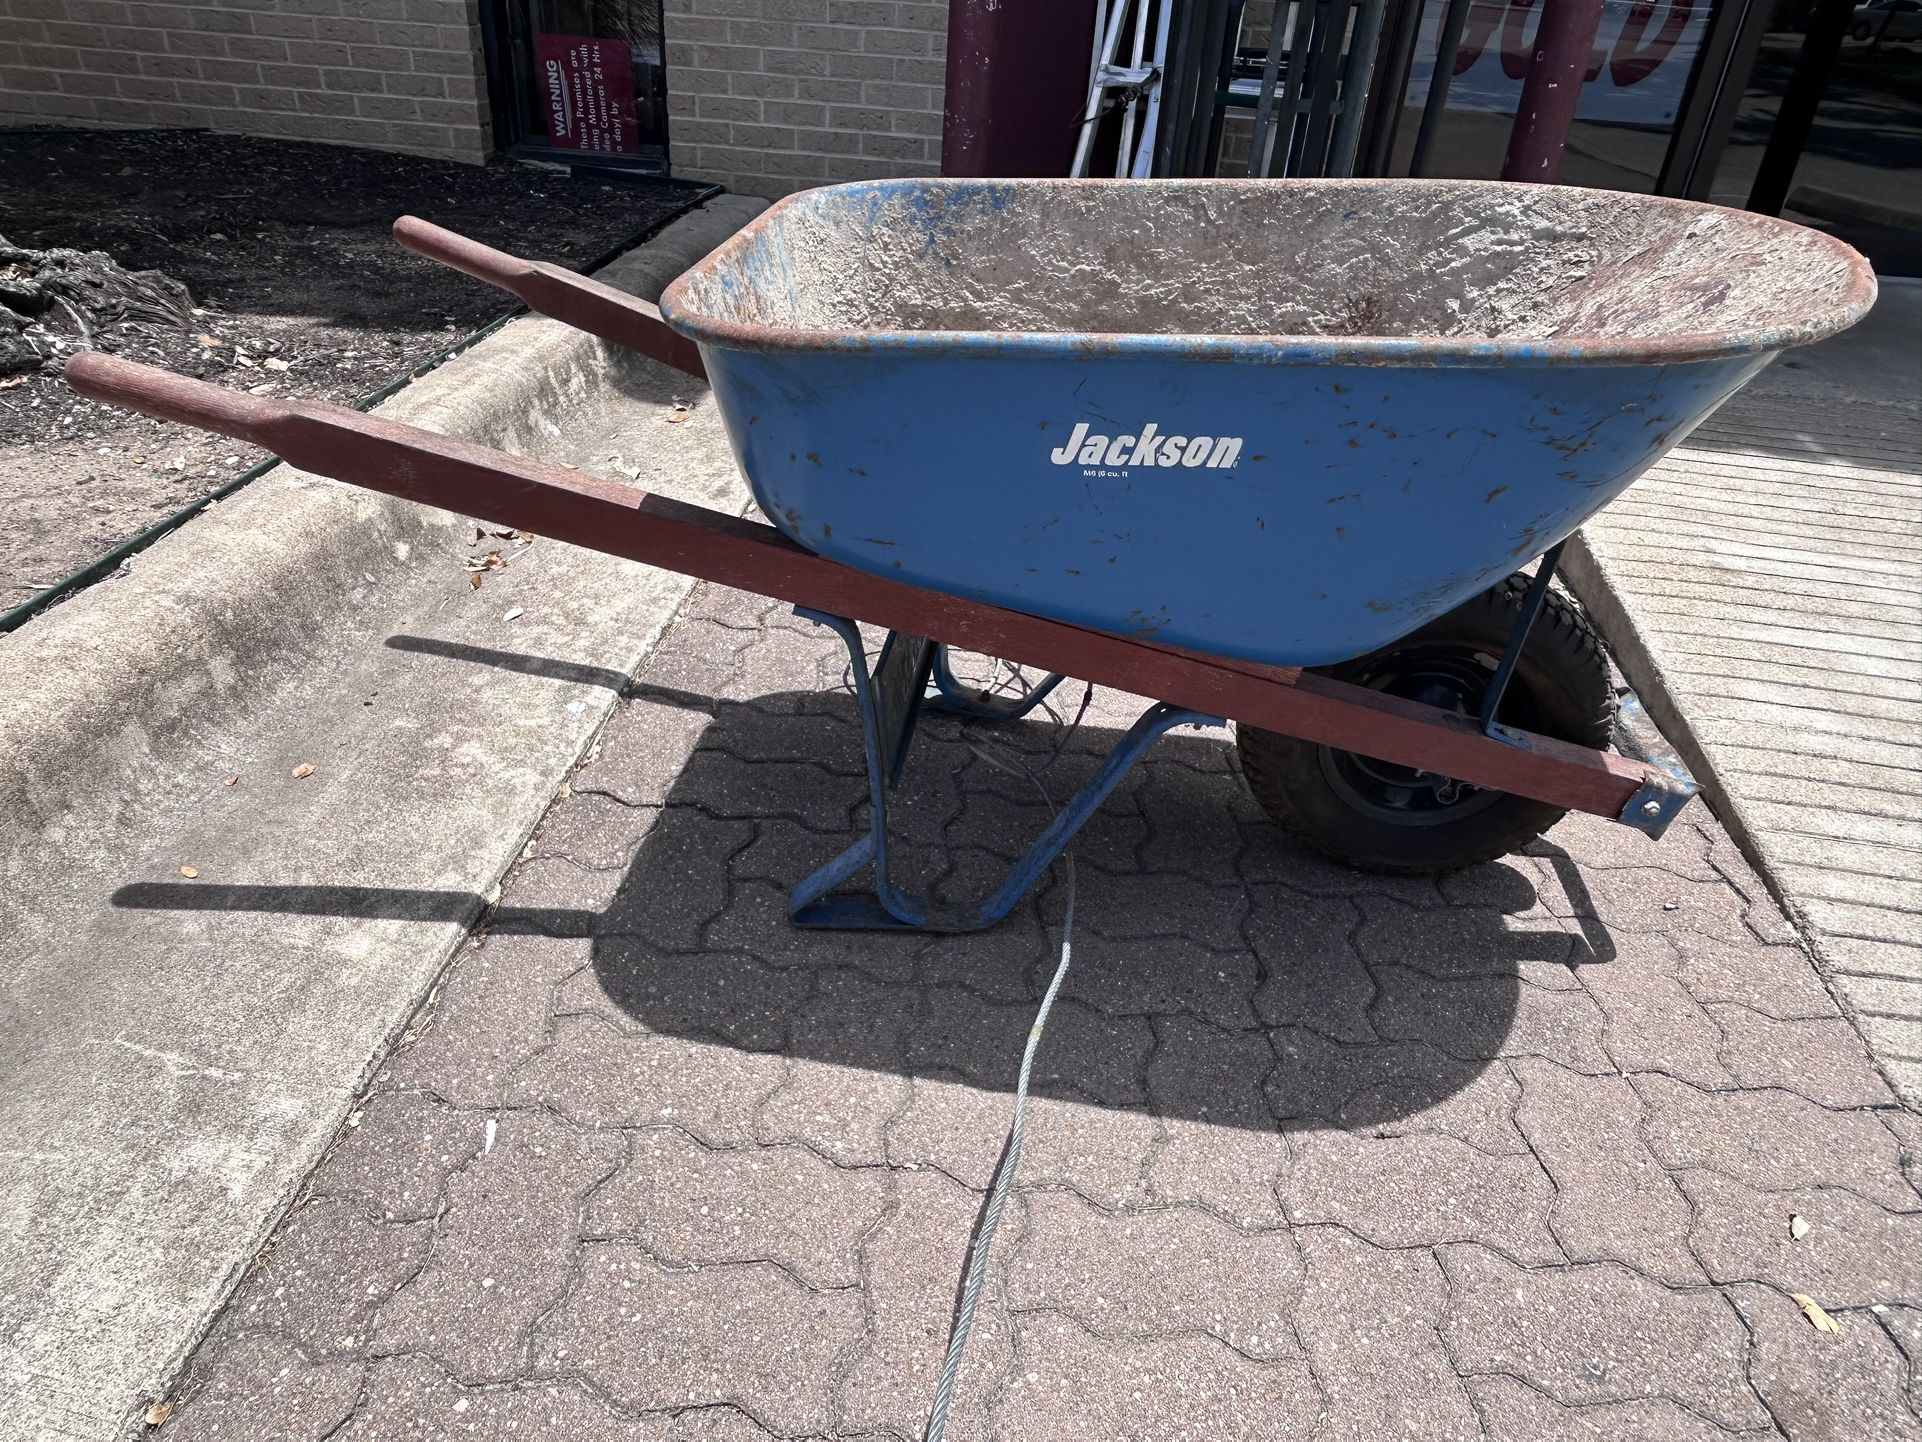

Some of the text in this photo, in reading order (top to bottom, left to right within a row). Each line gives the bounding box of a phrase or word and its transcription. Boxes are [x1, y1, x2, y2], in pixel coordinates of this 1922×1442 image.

[593, 67, 603, 80] 24
[546, 60, 566, 136] WARNING
[570, 50, 589, 149] These Premises are
[579, 44, 600, 150] eing Monitored with
[598, 85, 609, 128] Cameras
[610, 101, 619, 115] by
[602, 133, 611, 151] deo
[1050, 423, 1243, 468] Jackson
